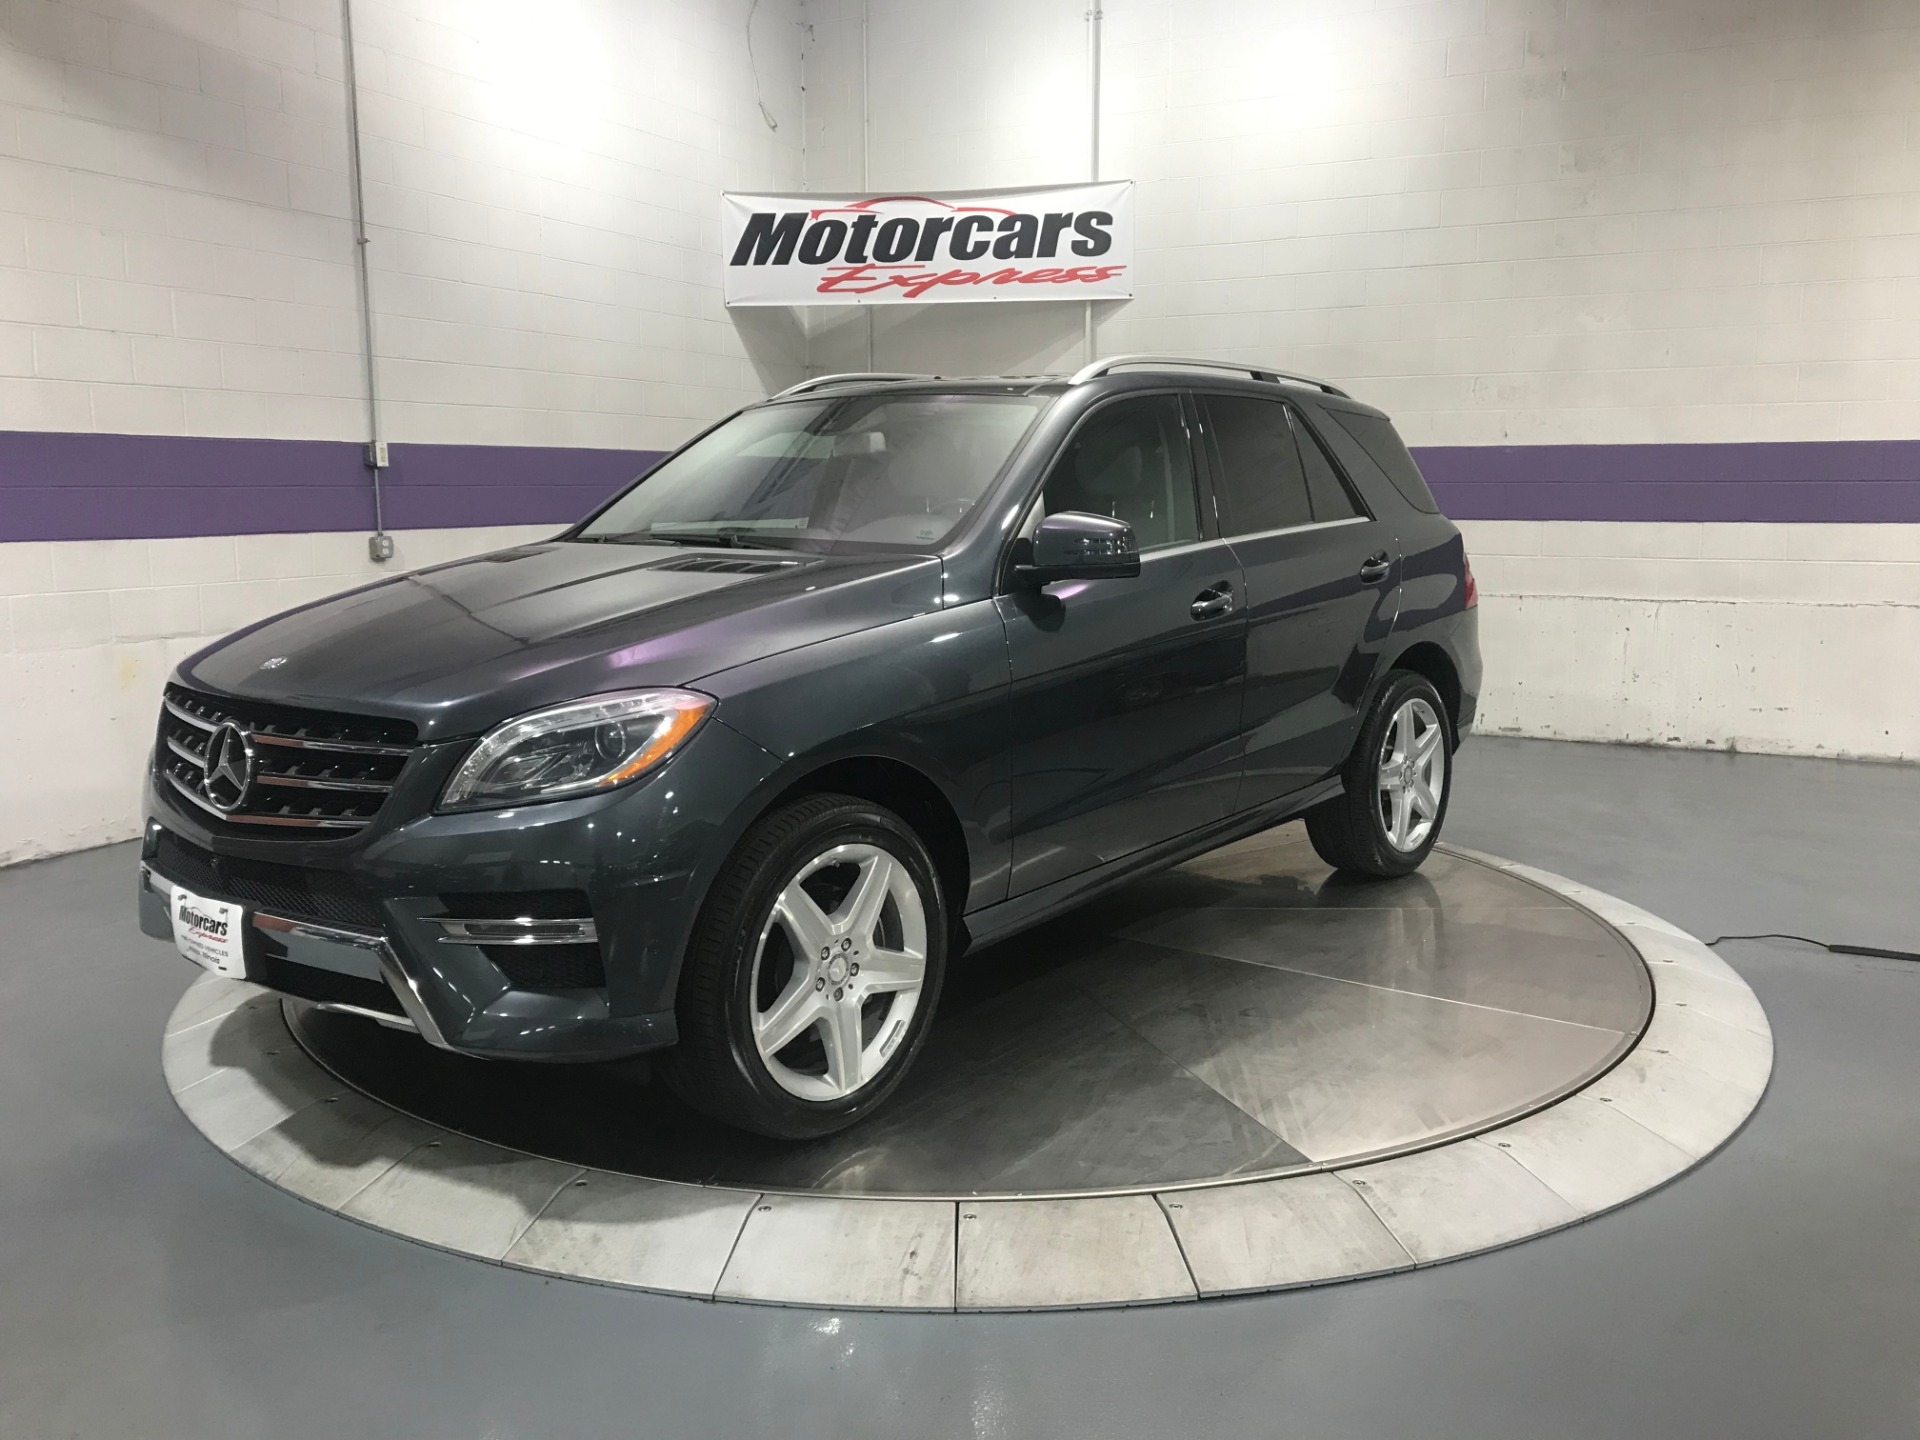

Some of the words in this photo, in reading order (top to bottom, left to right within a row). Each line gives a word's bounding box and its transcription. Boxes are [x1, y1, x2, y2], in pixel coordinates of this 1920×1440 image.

[729, 210, 1113, 266] Motorcars
[817, 263, 1127, 298] Express
[179, 905, 228, 936] Motorcars
